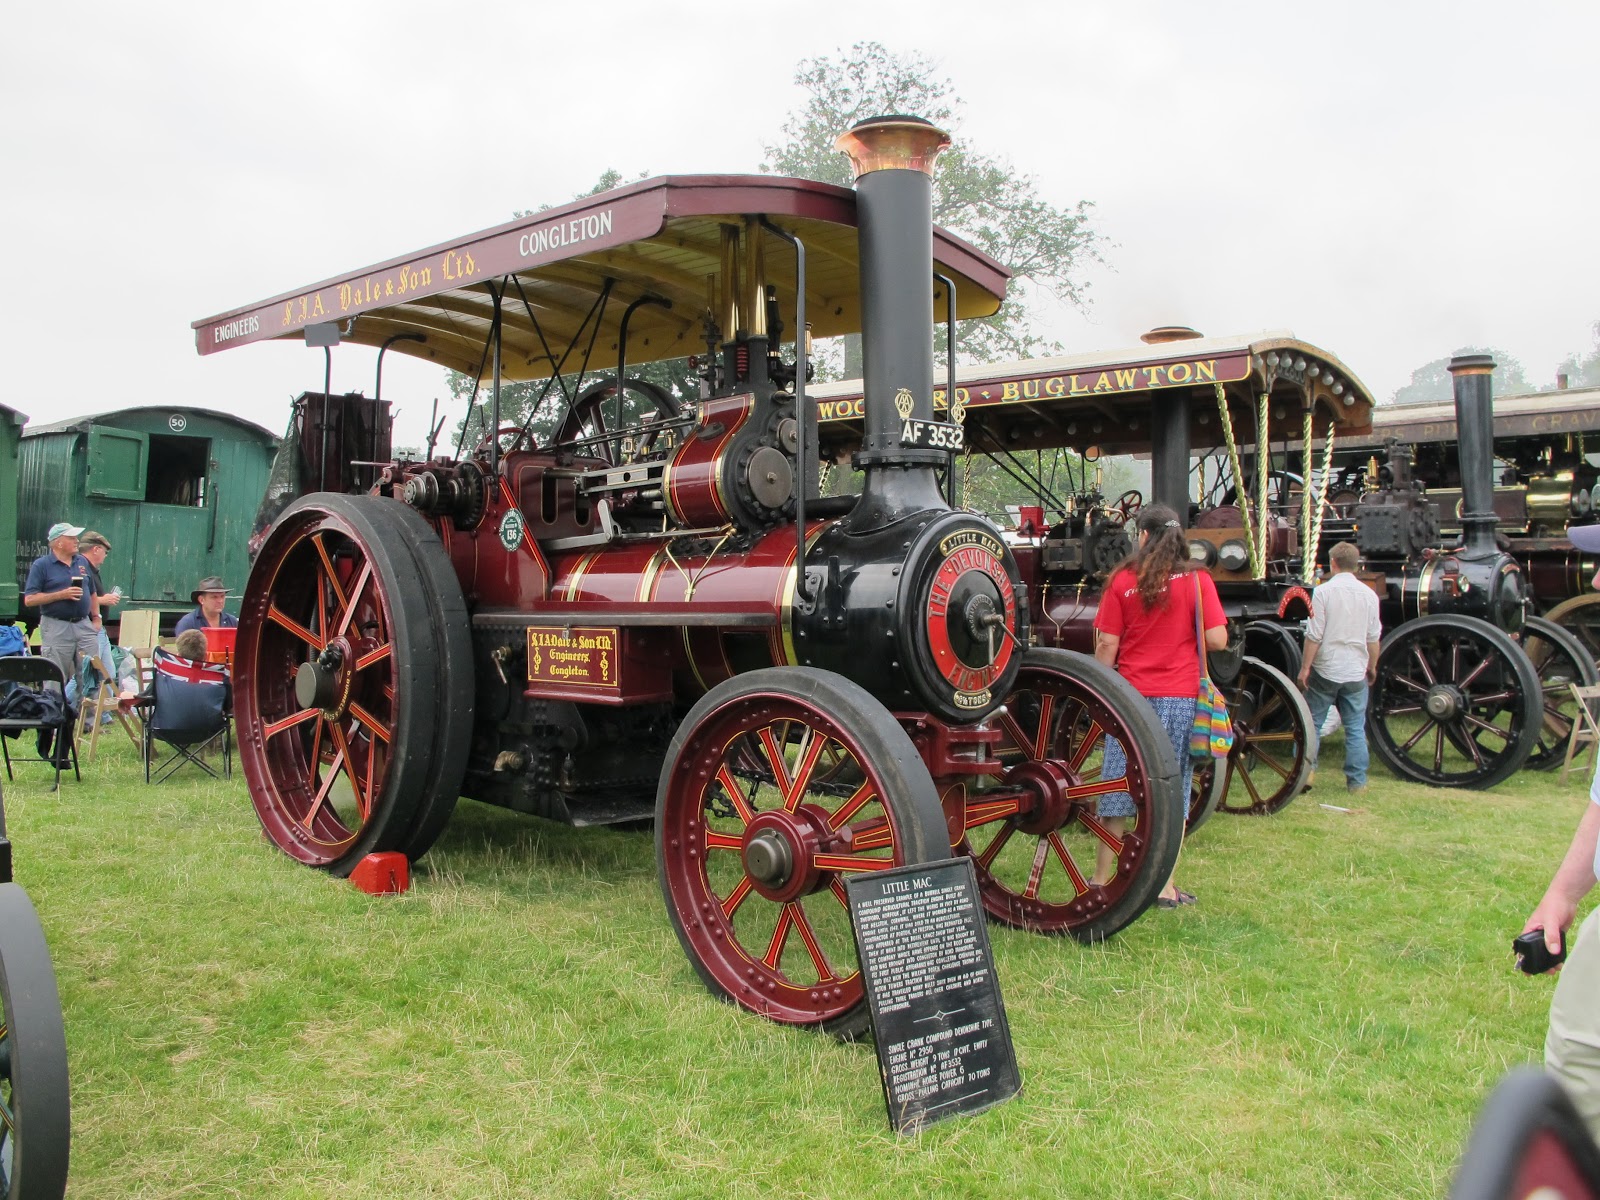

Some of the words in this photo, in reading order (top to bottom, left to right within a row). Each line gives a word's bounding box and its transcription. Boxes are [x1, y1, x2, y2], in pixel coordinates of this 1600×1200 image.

[520, 210, 612, 256] CONGLETON
[336, 278, 382, 312] Dale
[397, 265, 432, 295] Son
[442, 250, 481, 281] Ltd.
[214, 315, 260, 344] ENGINEERS
[1001, 359, 1218, 401] BUGLAWTON
[172, 418, 184, 427] 50
[901, 421, 924, 444] AF
[928, 424, 964, 450] 3532
[948, 534, 976, 548] LITTLE
[981, 536, 996, 552] MAC
[928, 576, 951, 619] THE
[550, 664, 590, 678] Congleton.
[948, 664, 997, 689] ENGINE
[882, 881, 909, 894] LITTLE
[913, 877, 932, 889] MAC
[889, 1042, 904, 1054] SINGLE
[907, 1037, 924, 1049] CRANK
[926, 1030, 953, 1044] COMPOUND
[955, 1022, 979, 1036] DEVONSHIRE
[890, 1052, 907, 1064] ENGINE
[919, 1045, 933, 1056] 2950
[891, 1063, 908, 1074] GROSS
[911, 1056, 928, 1069] WEIGHT
[933, 1054, 937, 1062] 9
[938, 1050, 950, 1060] TONS
[894, 1068, 927, 1084] REGISTRATION
[898, 1091, 914, 1103] GROSS
[941, 1076, 964, 1090] CAPACITY
[976, 1068, 990, 1078] TONS
[922, 1074, 937, 1085] HORSE
[940, 1069, 957, 1080] POWER
[960, 1066, 964, 1074] 6
